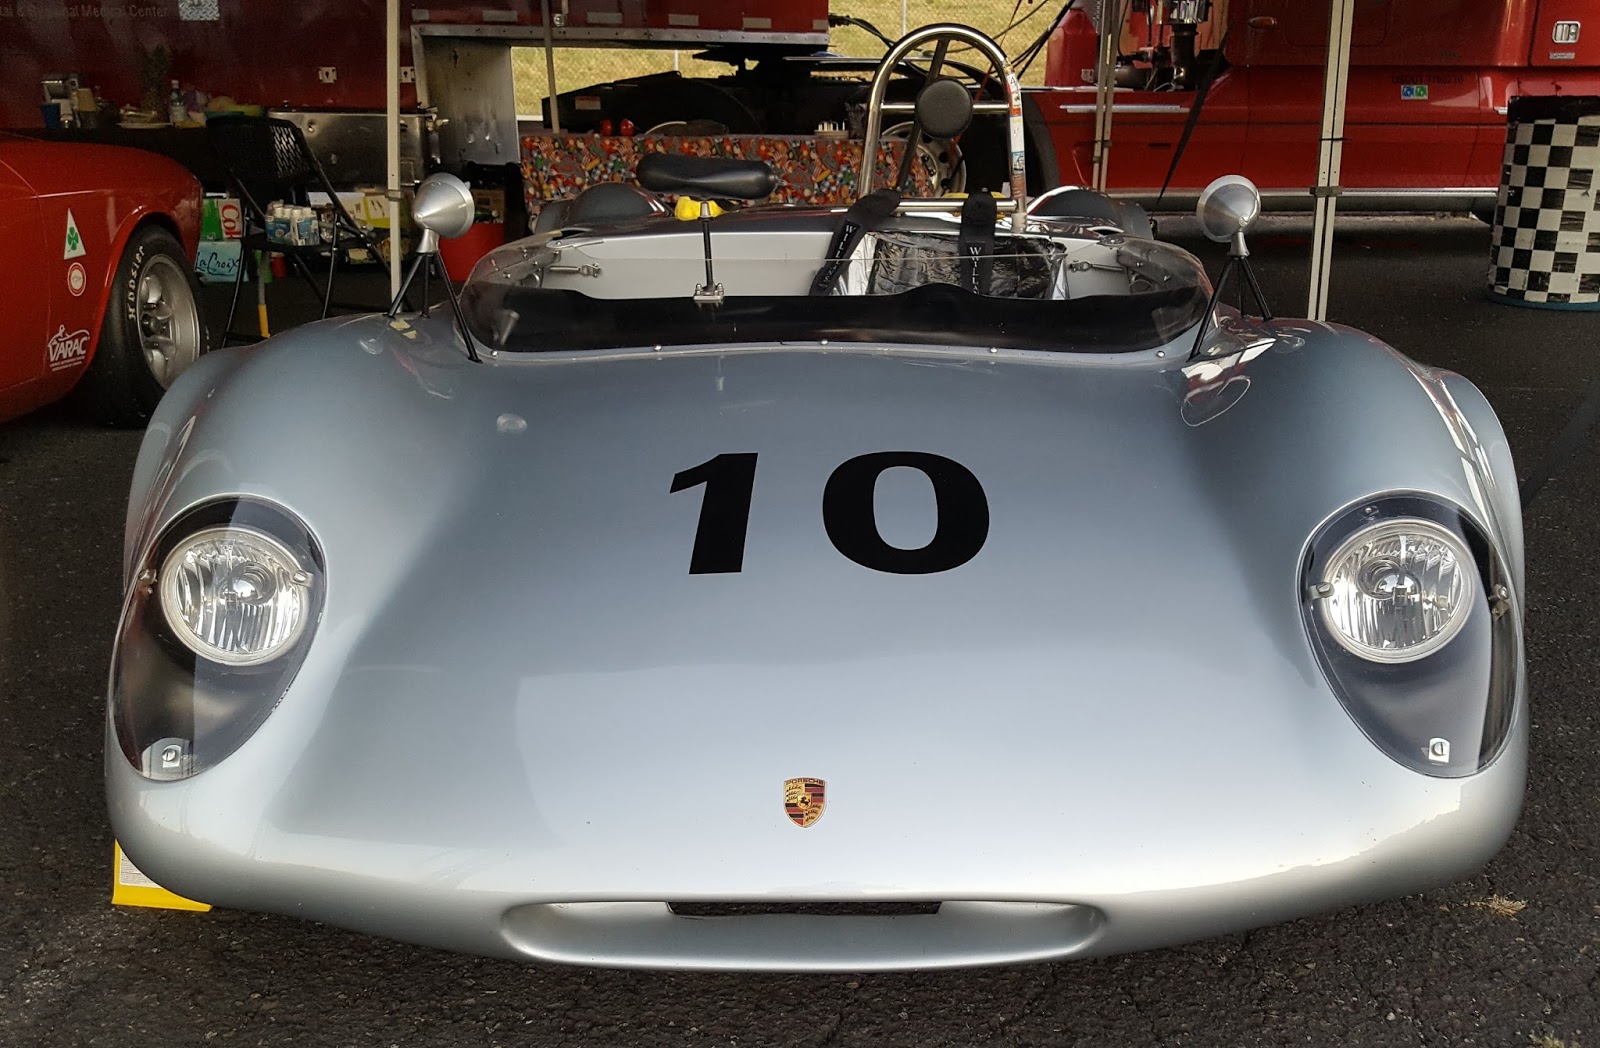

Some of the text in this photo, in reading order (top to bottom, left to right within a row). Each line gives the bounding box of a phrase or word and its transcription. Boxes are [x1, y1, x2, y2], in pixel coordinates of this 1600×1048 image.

[129, 4, 168, 17] Center
[48, 336, 89, 362] VARAC
[669, 451, 990, 575] 10
